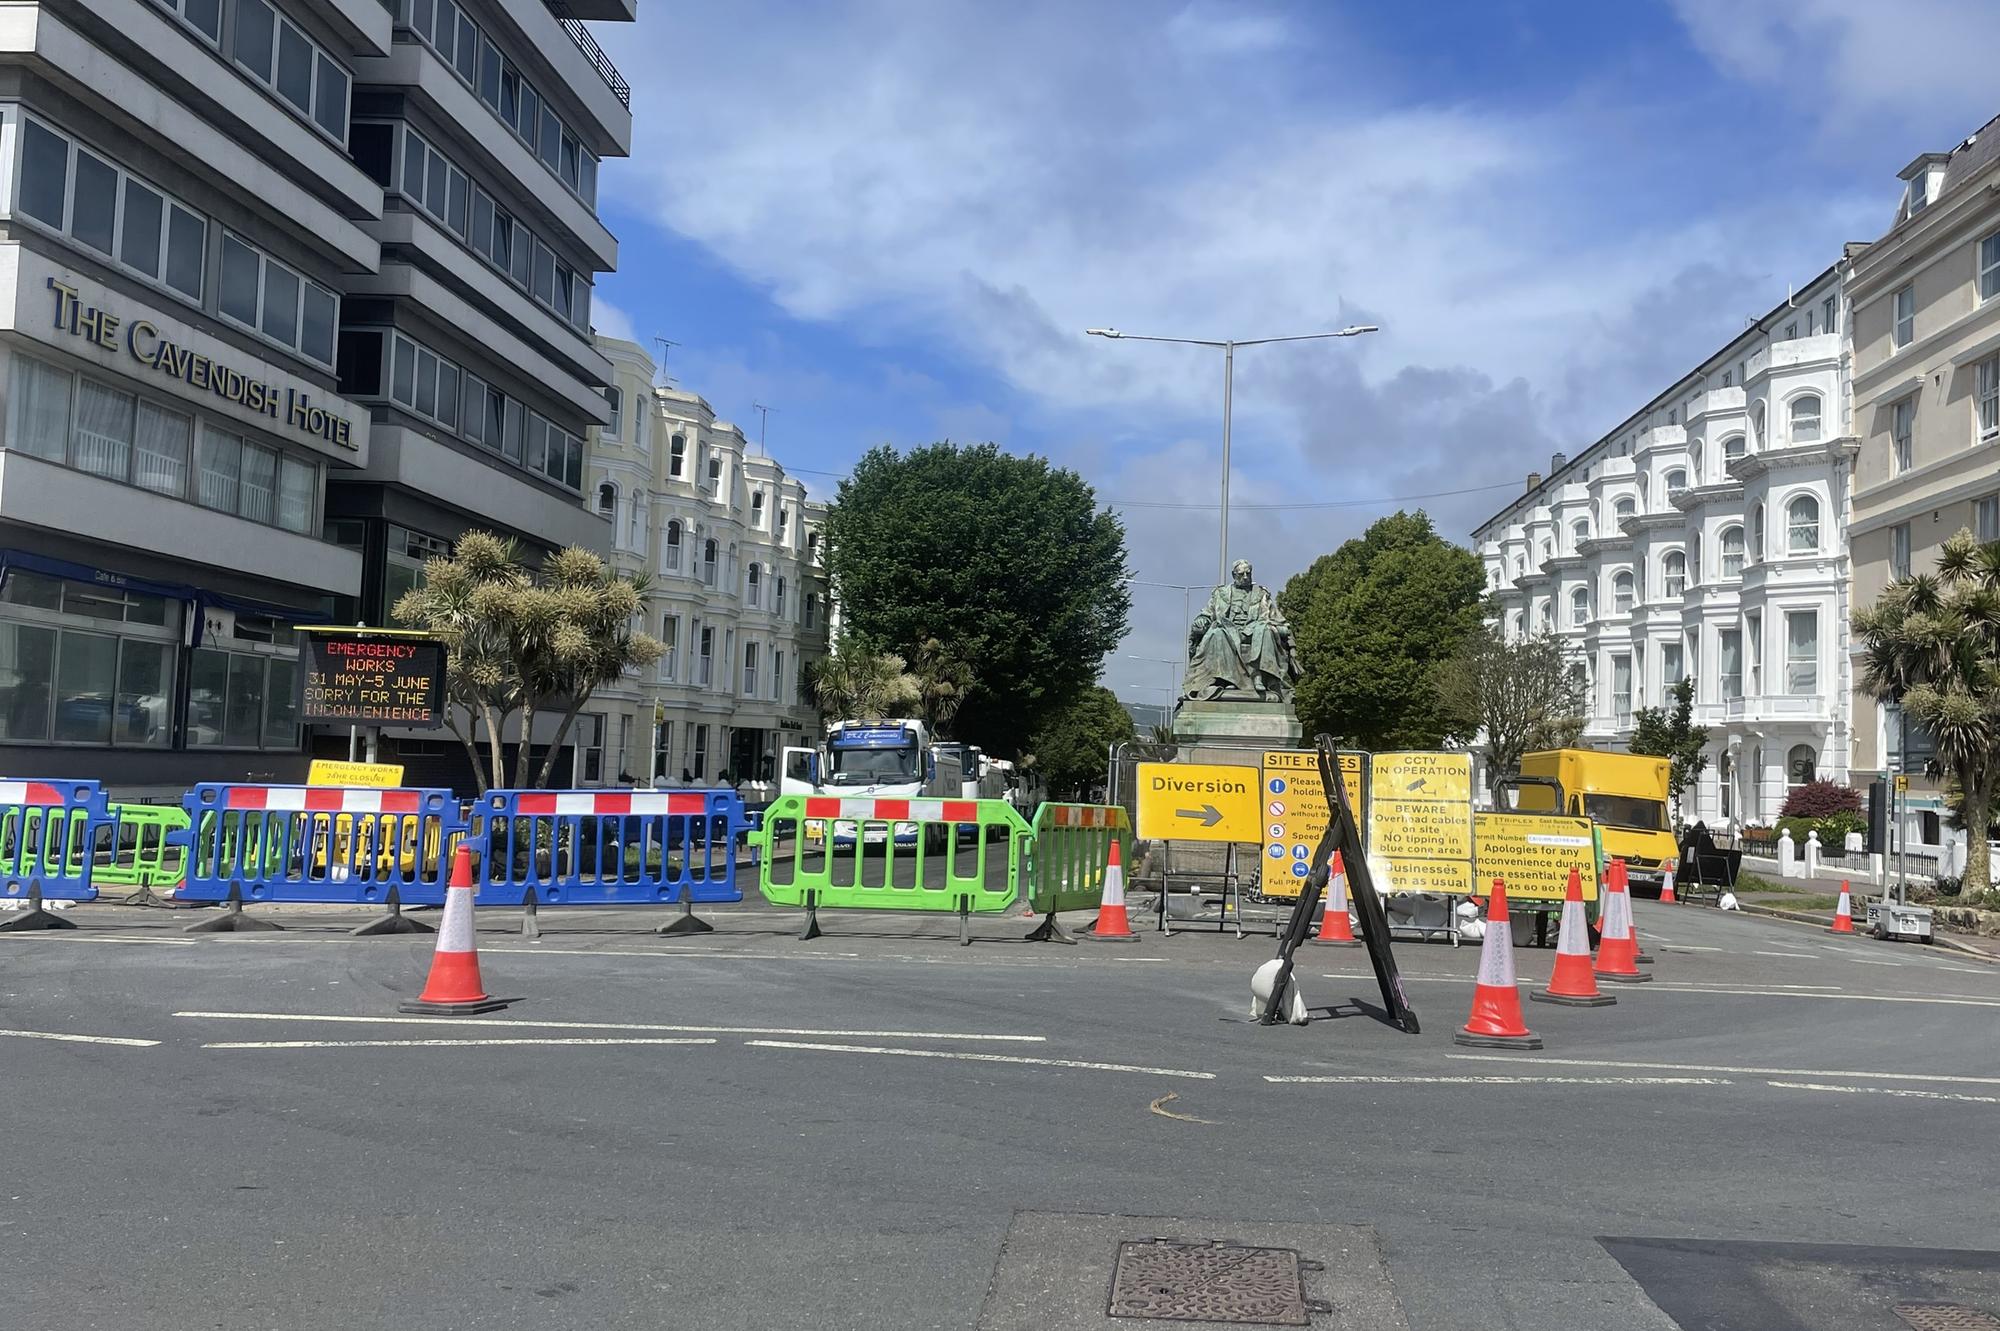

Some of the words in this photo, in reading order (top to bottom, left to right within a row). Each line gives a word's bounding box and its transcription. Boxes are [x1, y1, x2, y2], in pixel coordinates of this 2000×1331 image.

[327, 642, 416, 658] EMERGENCY
[346, 658, 396, 673] WORKS
[309, 672, 326, 685] 31
[391, 676, 430, 690] JUNE
[304, 687, 354, 701] SORRY
[360, 690, 389, 703] FOR
[397, 691, 426, 705] THE
[305, 703, 431, 721] INCONVENIENCE
[1268, 755, 1301, 766] SITE
[1307, 756, 1356, 768] RES
[1404, 756, 1437, 765] CCTV
[316, 762, 367, 772] EMERGENCY
[370, 765, 399, 774] WORKS
[1375, 767, 1389, 775] IN
[1393, 767, 1467, 776] OPERATION
[349, 773, 385, 783] CLOSURE
[1290, 777, 1322, 786] Please
[1152, 776, 1246, 794] Diversion
[1395, 805, 1447, 814] BEWARE
[1375, 814, 1428, 824] Overhead
[1431, 816, 1468, 825] cables
[1273, 826, 1281, 836] 5
[1420, 825, 1440, 834] site
[1292, 832, 1320, 840] Speed
[1383, 833, 1402, 842] NO
[1406, 834, 1445, 845] tipping
[1448, 836, 1459, 844] in
[1380, 844, 1404, 852] blue
[1437, 847, 1462, 855] area
[1484, 843, 1538, 856] Apologies
[1541, 845, 1556, 854] for
[1560, 848, 1579, 857] any
[1556, 858, 1591, 871] during
[1507, 871, 1556, 881] essential
[1560, 874, 1593, 882] wks
[1412, 877, 1427, 885] as
[1431, 878, 1468, 888] usual
